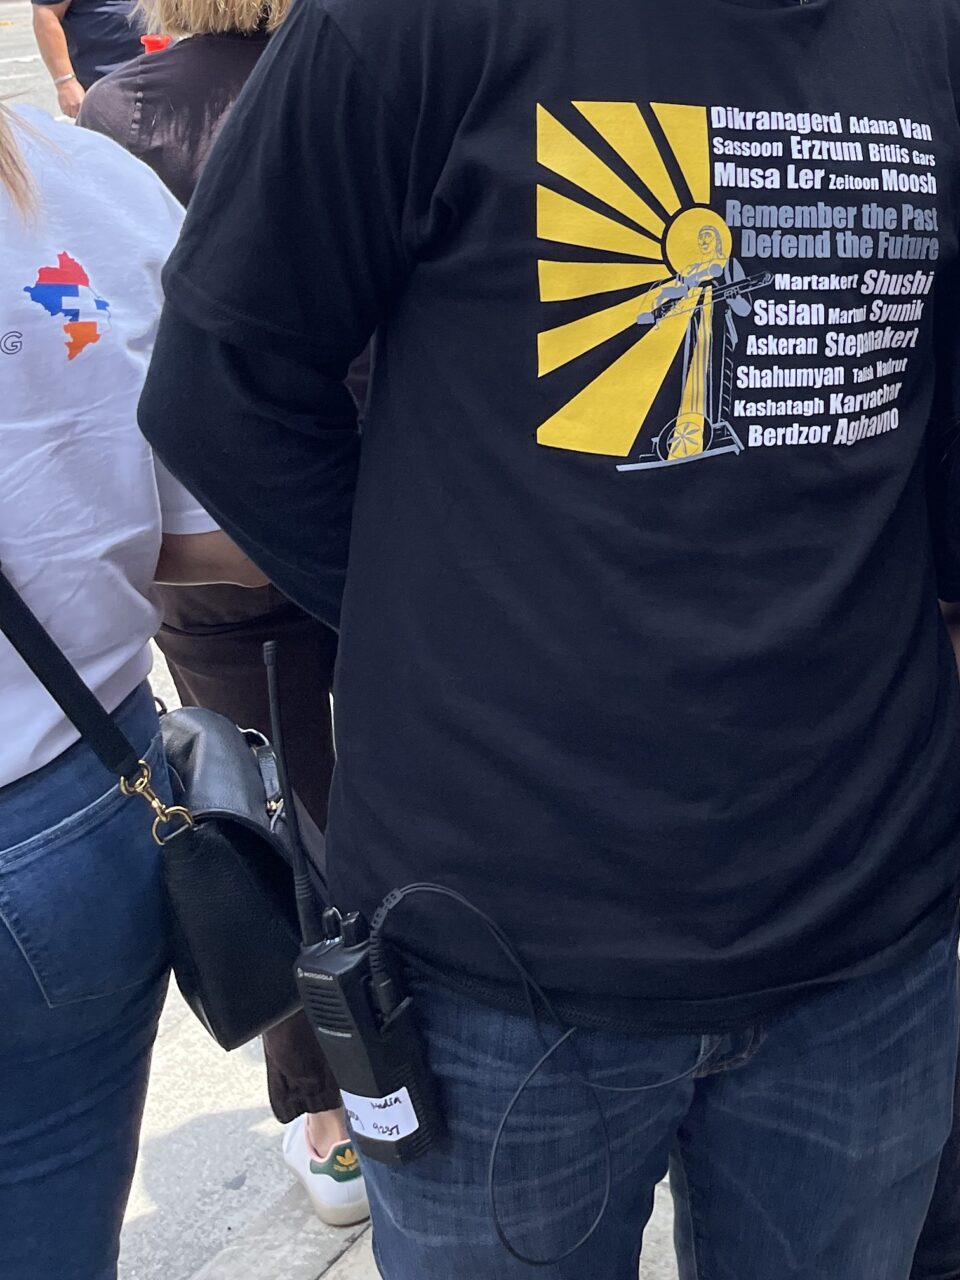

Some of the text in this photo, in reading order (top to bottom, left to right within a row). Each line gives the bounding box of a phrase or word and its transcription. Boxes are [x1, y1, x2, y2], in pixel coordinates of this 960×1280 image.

[711, 106, 933, 141] Dikranagerd Adana Van
[713, 135, 936, 166] Sassoon Erzrum Bitlis Gars
[714, 162, 937, 194] Musa Ler Zeitoon Moosh
[725, 199, 939, 232] Remember the Past
[741, 229, 940, 261] Defend the Future
[774, 269, 935, 296] Martakert Shushi
[754, 299, 825, 326] Sisian
[869, 299, 924, 324] Syunik
[746, 326, 919, 357] Askeran Stepanakert
[736, 366, 844, 389] Shahumyan
[733, 382, 902, 417] Kashatagh Karvachar
[748, 408, 899, 447] Berdzor Aghavno
